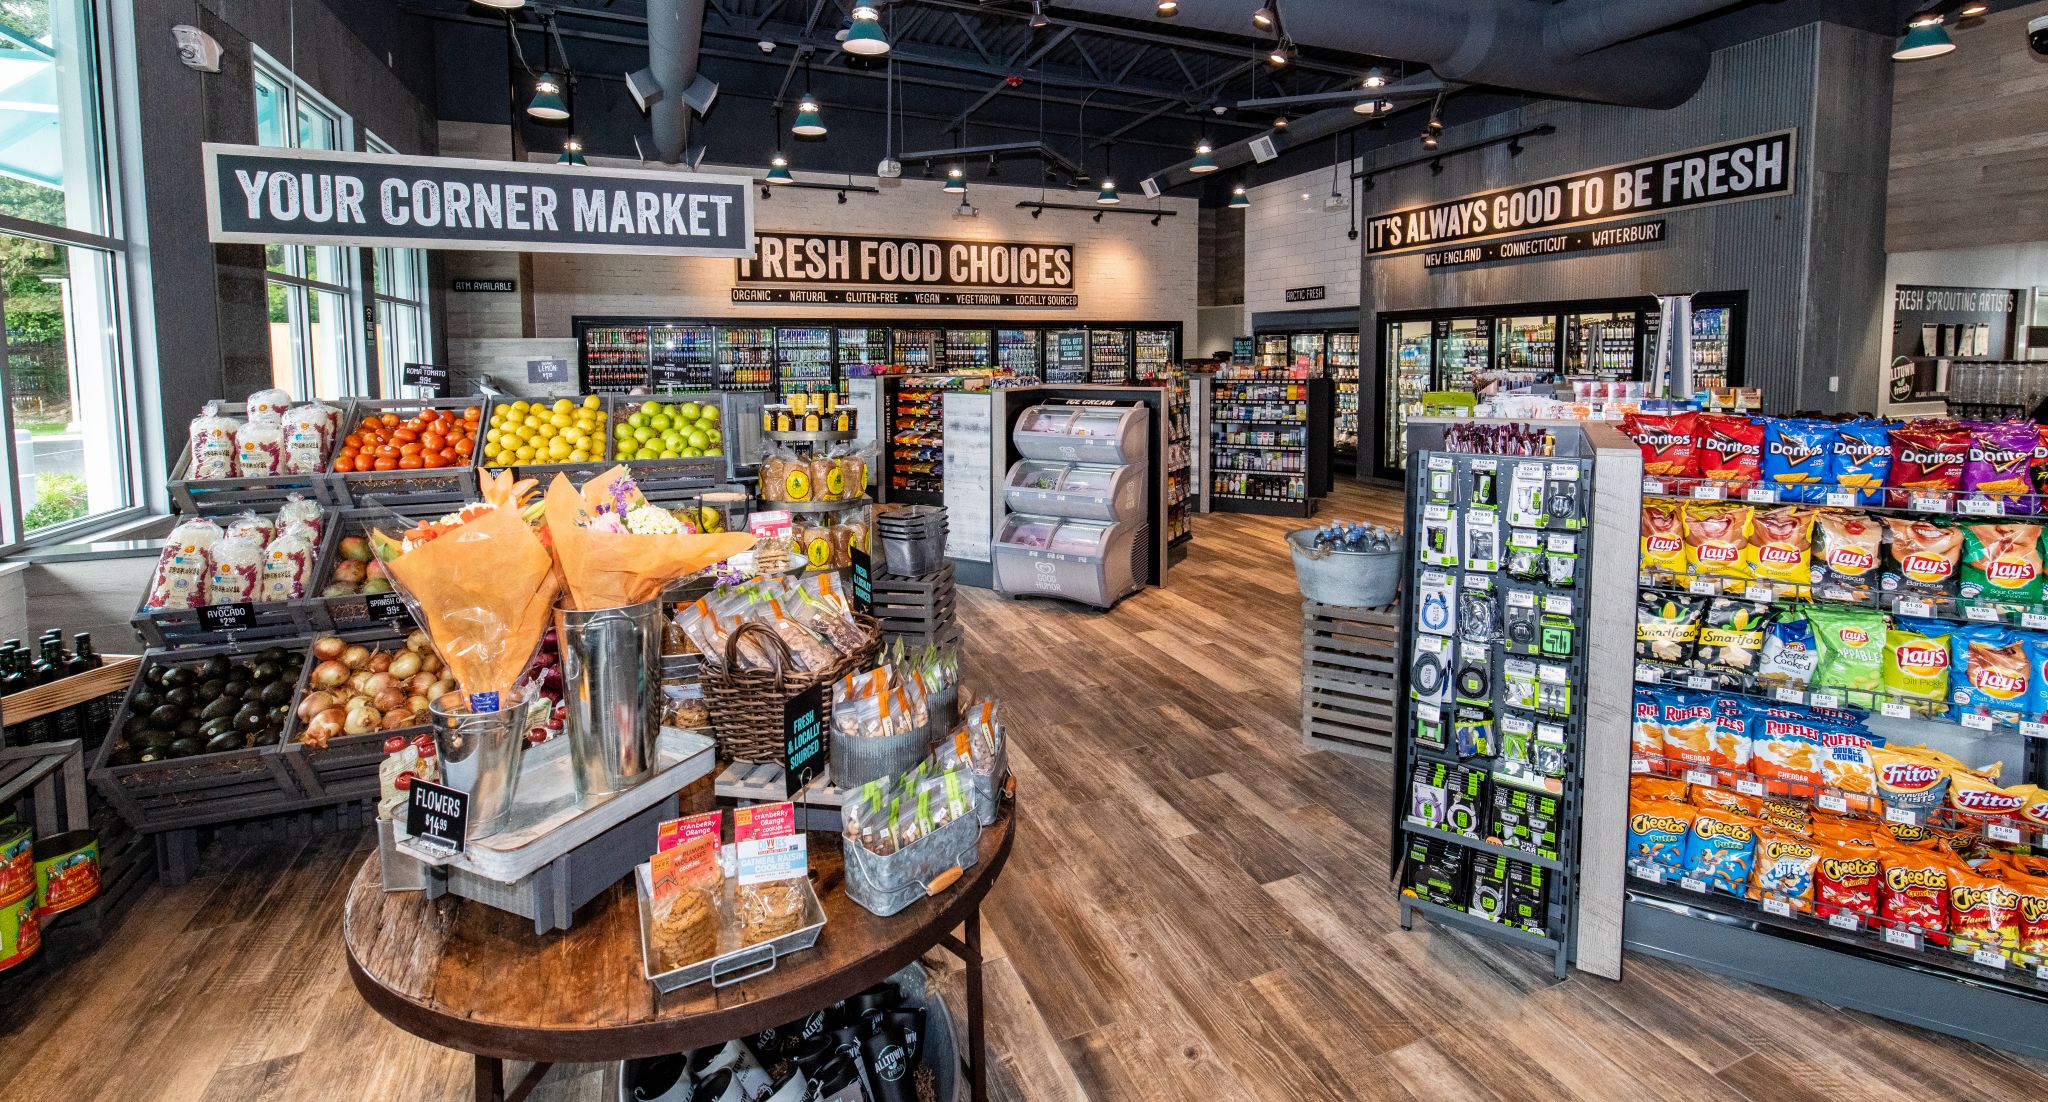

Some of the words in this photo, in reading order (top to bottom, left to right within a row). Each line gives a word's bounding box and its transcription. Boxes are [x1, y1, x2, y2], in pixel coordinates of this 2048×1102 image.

[234, 170, 367, 224] YOUR
[379, 178, 559, 231] CORNER
[572, 188, 733, 237] MARKET
[1368, 217, 1402, 249] IT'S
[1407, 200, 1488, 243] ALWAYS
[1493, 185, 1561, 230] GOOD
[1568, 177, 1604, 217] TO
[1613, 167, 1653, 211] BE
[1662, 141, 1783, 203] FRESH
[1425, 252, 1441, 267] NEW
[1443, 247, 1481, 265] ENGLAND
[1500, 236, 1567, 258] CONNECTICUT
[1592, 224, 1661, 247] WATERBURY
[860, 241, 942, 282] FOOD
[950, 244, 1072, 286] CHOICES
[456, 282, 472, 290] ATM
[474, 282, 512, 291] AVAILABLE
[1286, 289, 1305, 301] ARCTIC
[1306, 287, 1323, 299] FRESH
[732, 289, 771, 302] ORGANIC
[790, 290, 828, 303] NATURAL
[846, 292, 899, 304] GLUTEN-FREE
[914, 293, 940, 304] VEGAN
[956, 294, 1001, 305] VEGETARIAN
[1015, 294, 1046, 306] LOCALLY
[1047, 295, 1077, 307] SOURCED
[1895, 289, 1924, 311] FRESH
[1926, 290, 1976, 312] SPROUTING
[1978, 292, 2014, 313] ARTISTS
[423, 369, 446, 377] TOMATO
[538, 364, 557, 372] LEMON
[1894, 383, 1910, 395] fresh
[1639, 433, 1691, 446] Doritos
[1706, 438, 1760, 455] Doritos
[1770, 442, 1823, 456] Doritos
[1834, 442, 1892, 456] Doritos
[1901, 450, 1964, 464] Doritos
[1969, 449, 2030, 462] Dorito
[1650, 538, 1680, 551] Lay's
[1700, 546, 1735, 561] Lay's
[1761, 547, 1799, 562] Lay's
[1832, 550, 1872, 568] Lay's
[1766, 569, 1791, 577] Classic
[1907, 556, 1949, 577] Lay's
[1991, 563, 2032, 581] Lay's
[1830, 572, 1866, 582] Barbecue
[1906, 580, 1944, 589] Barbecue
[370, 598, 395, 607] SPANISH
[207, 607, 246, 618] AVOCADO
[1841, 629, 1867, 641] Lay's
[1774, 654, 1811, 671] Cooked
[1903, 647, 1946, 667] Lay's
[1919, 679, 1944, 687] Pickle
[1980, 671, 2024, 691] Lay's
[1973, 694, 1987, 702] Salt
[1996, 699, 2024, 709] Vinegar
[793, 709, 814, 733] FRESH
[1666, 705, 1711, 721] RUFFLES
[1716, 715, 1744, 732] FLES
[1766, 720, 1820, 742] RUFFLES
[787, 741, 793, 755] &
[794, 721, 821, 748] LOCALLY
[790, 739, 819, 770] SOURCED
[1681, 753, 1711, 762] CHEDDAR
[1832, 754, 1864, 763] CRUNCH
[1777, 771, 1809, 782] CHEDDAR
[1882, 764, 1939, 784] Fritos
[415, 787, 461, 818] FLOWERS
[1958, 789, 2023, 808] Fritos
[1631, 814, 1688, 835] Cheetos
[1696, 818, 1751, 842] Cheetos
[1891, 824, 1922, 838] etos
[682, 840, 712, 857] PUMPKIN
[1767, 842, 1813, 859] Cheetos
[674, 849, 707, 867] MOLASSES
[741, 855, 777, 867] OATMEAL
[777, 851, 805, 863] RAISIN
[755, 862, 791, 873] COOKIES
[1823, 859, 1877, 882] Cheetos
[1887, 868, 1947, 892] Cheetos
[1906, 889, 1939, 897] Crunchy
[1951, 887, 2019, 913] Cheetos
[874, 1046, 905, 1073] ALLTOWN
